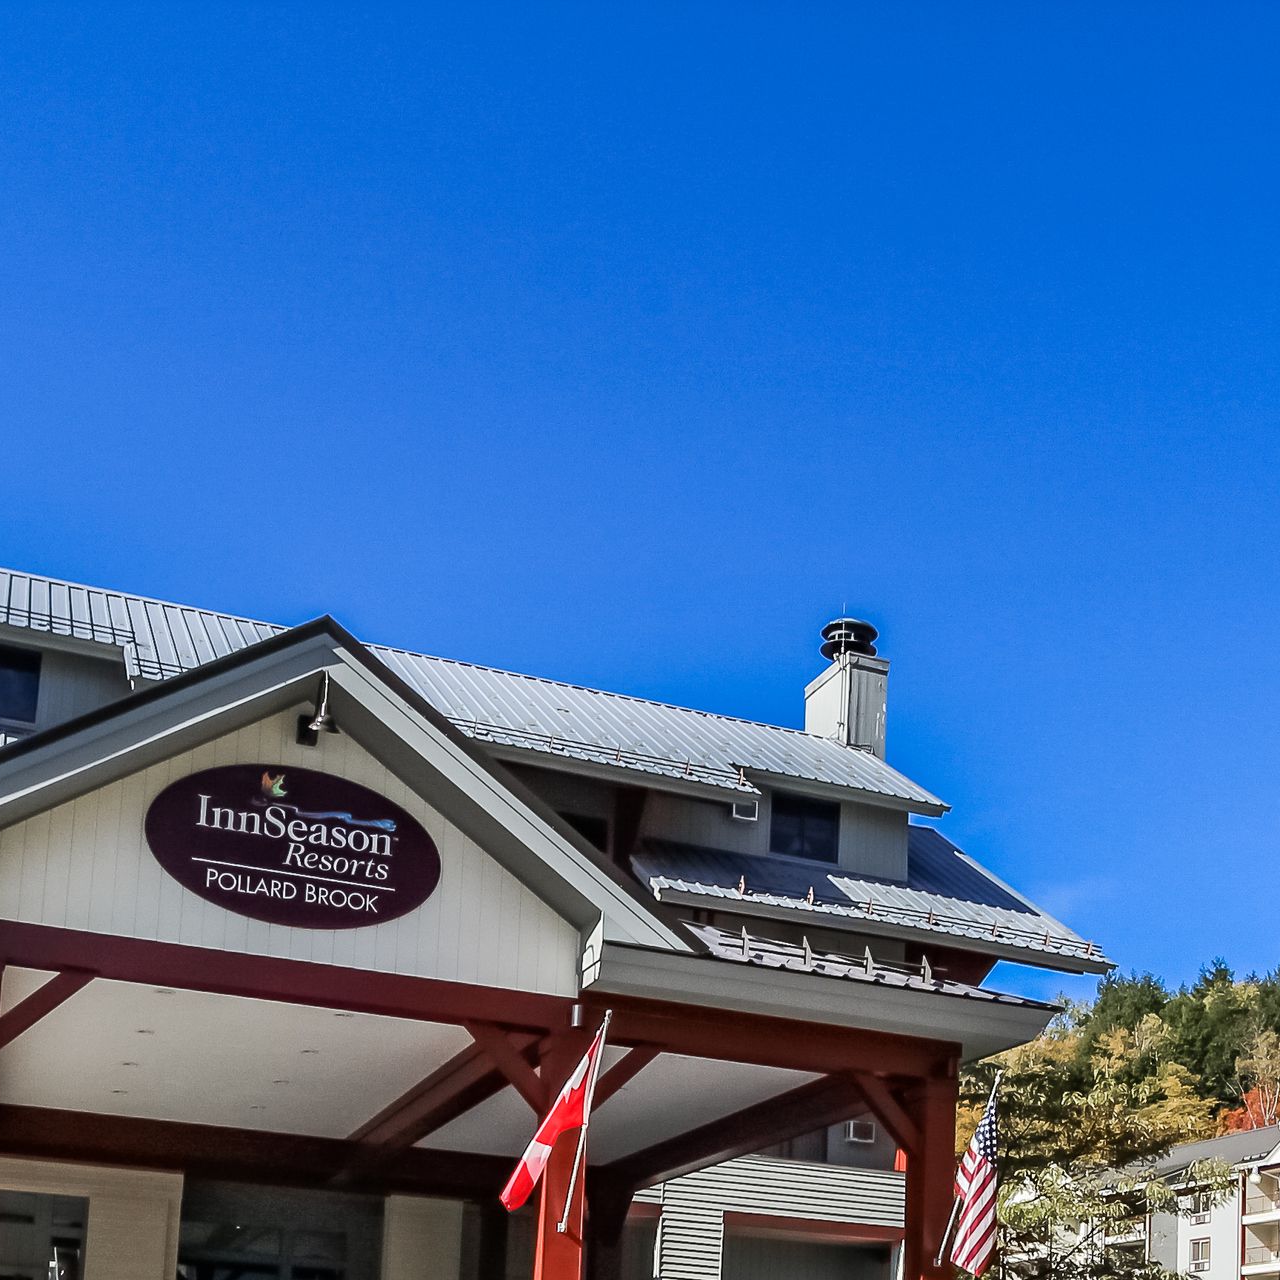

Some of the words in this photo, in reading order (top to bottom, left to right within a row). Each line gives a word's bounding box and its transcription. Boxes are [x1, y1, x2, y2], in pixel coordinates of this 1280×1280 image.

[196, 794, 394, 857] InnSeason
[282, 842, 390, 881] Resorts
[205, 868, 297, 900] POLLARD
[304, 883, 378, 913] BROOK
